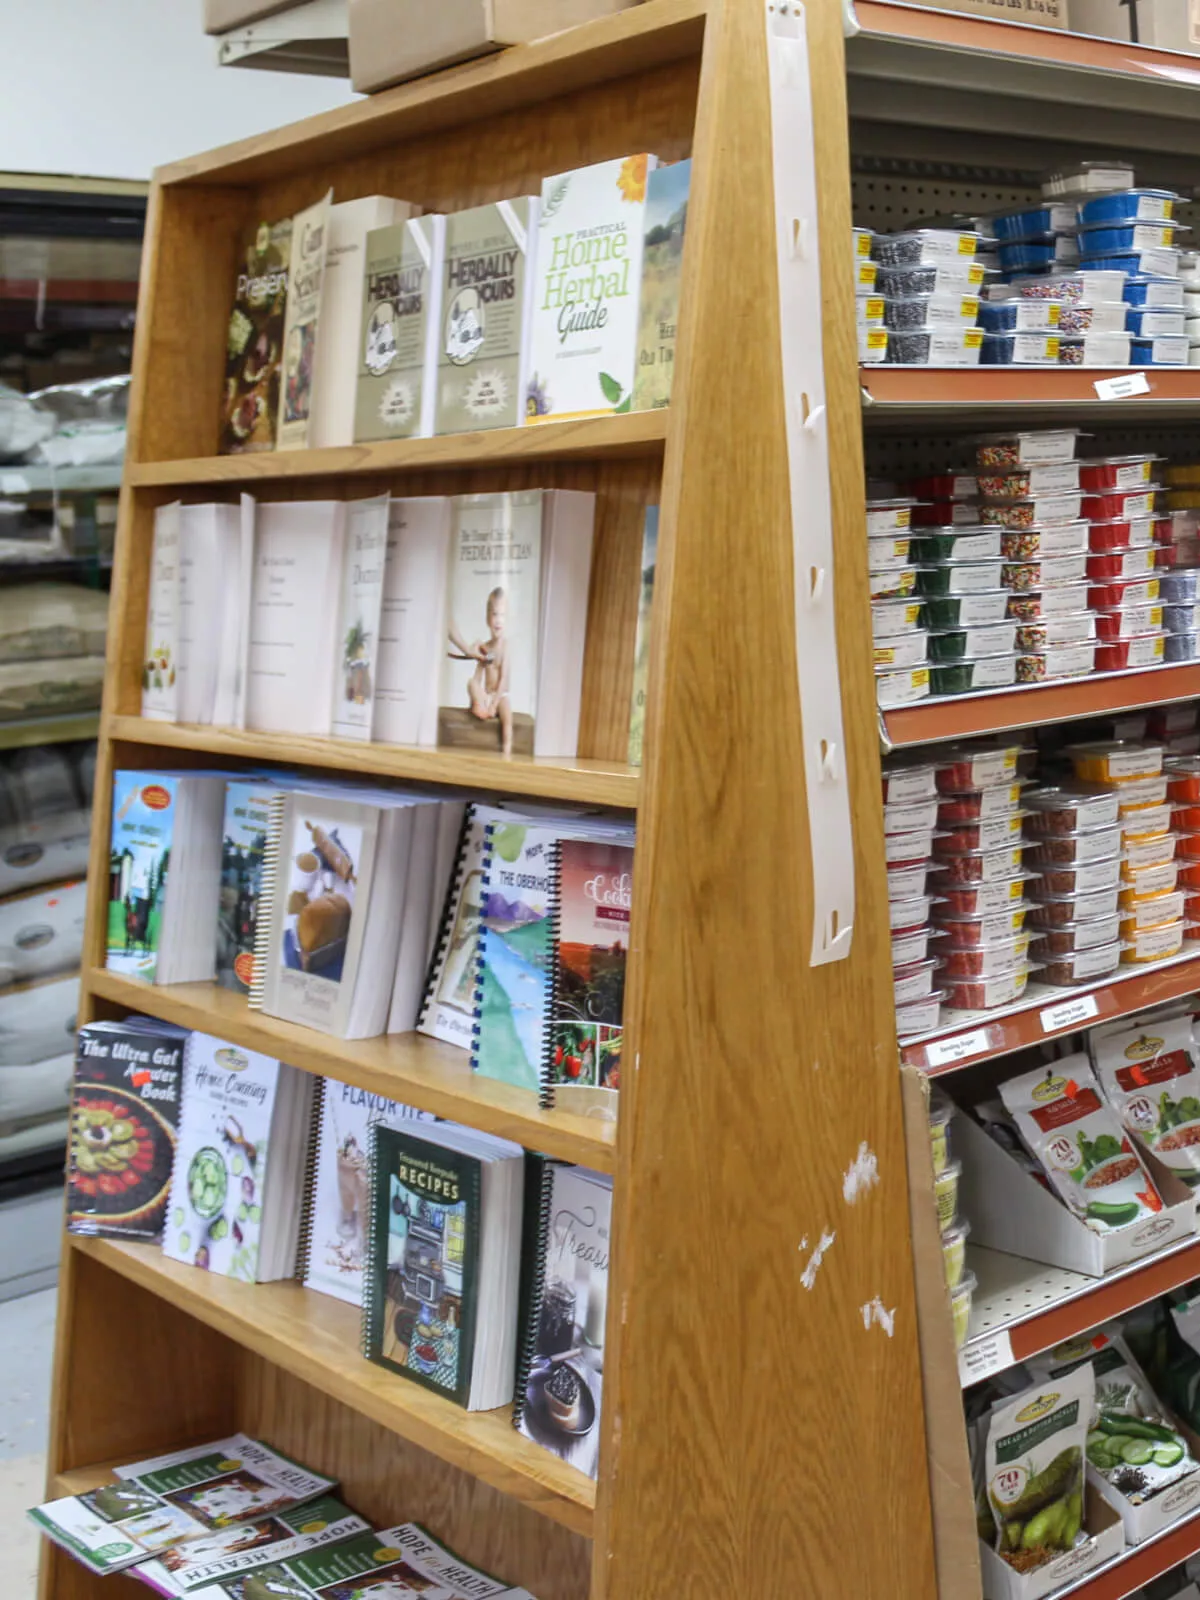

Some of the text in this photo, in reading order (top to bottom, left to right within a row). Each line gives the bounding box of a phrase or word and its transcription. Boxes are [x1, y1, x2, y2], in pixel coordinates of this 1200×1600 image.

[547, 232, 629, 272] Home
[541, 258, 631, 310] Herbal
[557, 296, 609, 344] Guide
[500, 870, 515, 887] THE
[83, 1039, 179, 1065] The Ultra Gel
[124, 1062, 178, 1083] Awer
[140, 1083, 176, 1102] Book
[1051, 1138, 1071, 1158] 70
[399, 1165, 459, 1200] RECIPES
[238, 1444, 272, 1466] HOPE
[274, 1466, 322, 1496] HEALTH
[998, 1471, 1019, 1488] 70
[305, 1519, 362, 1547] HOPE
[185, 1552, 269, 1582] HEALTH
[391, 1527, 434, 1557] HOPE
[438, 1565, 495, 1596] HEALTH
